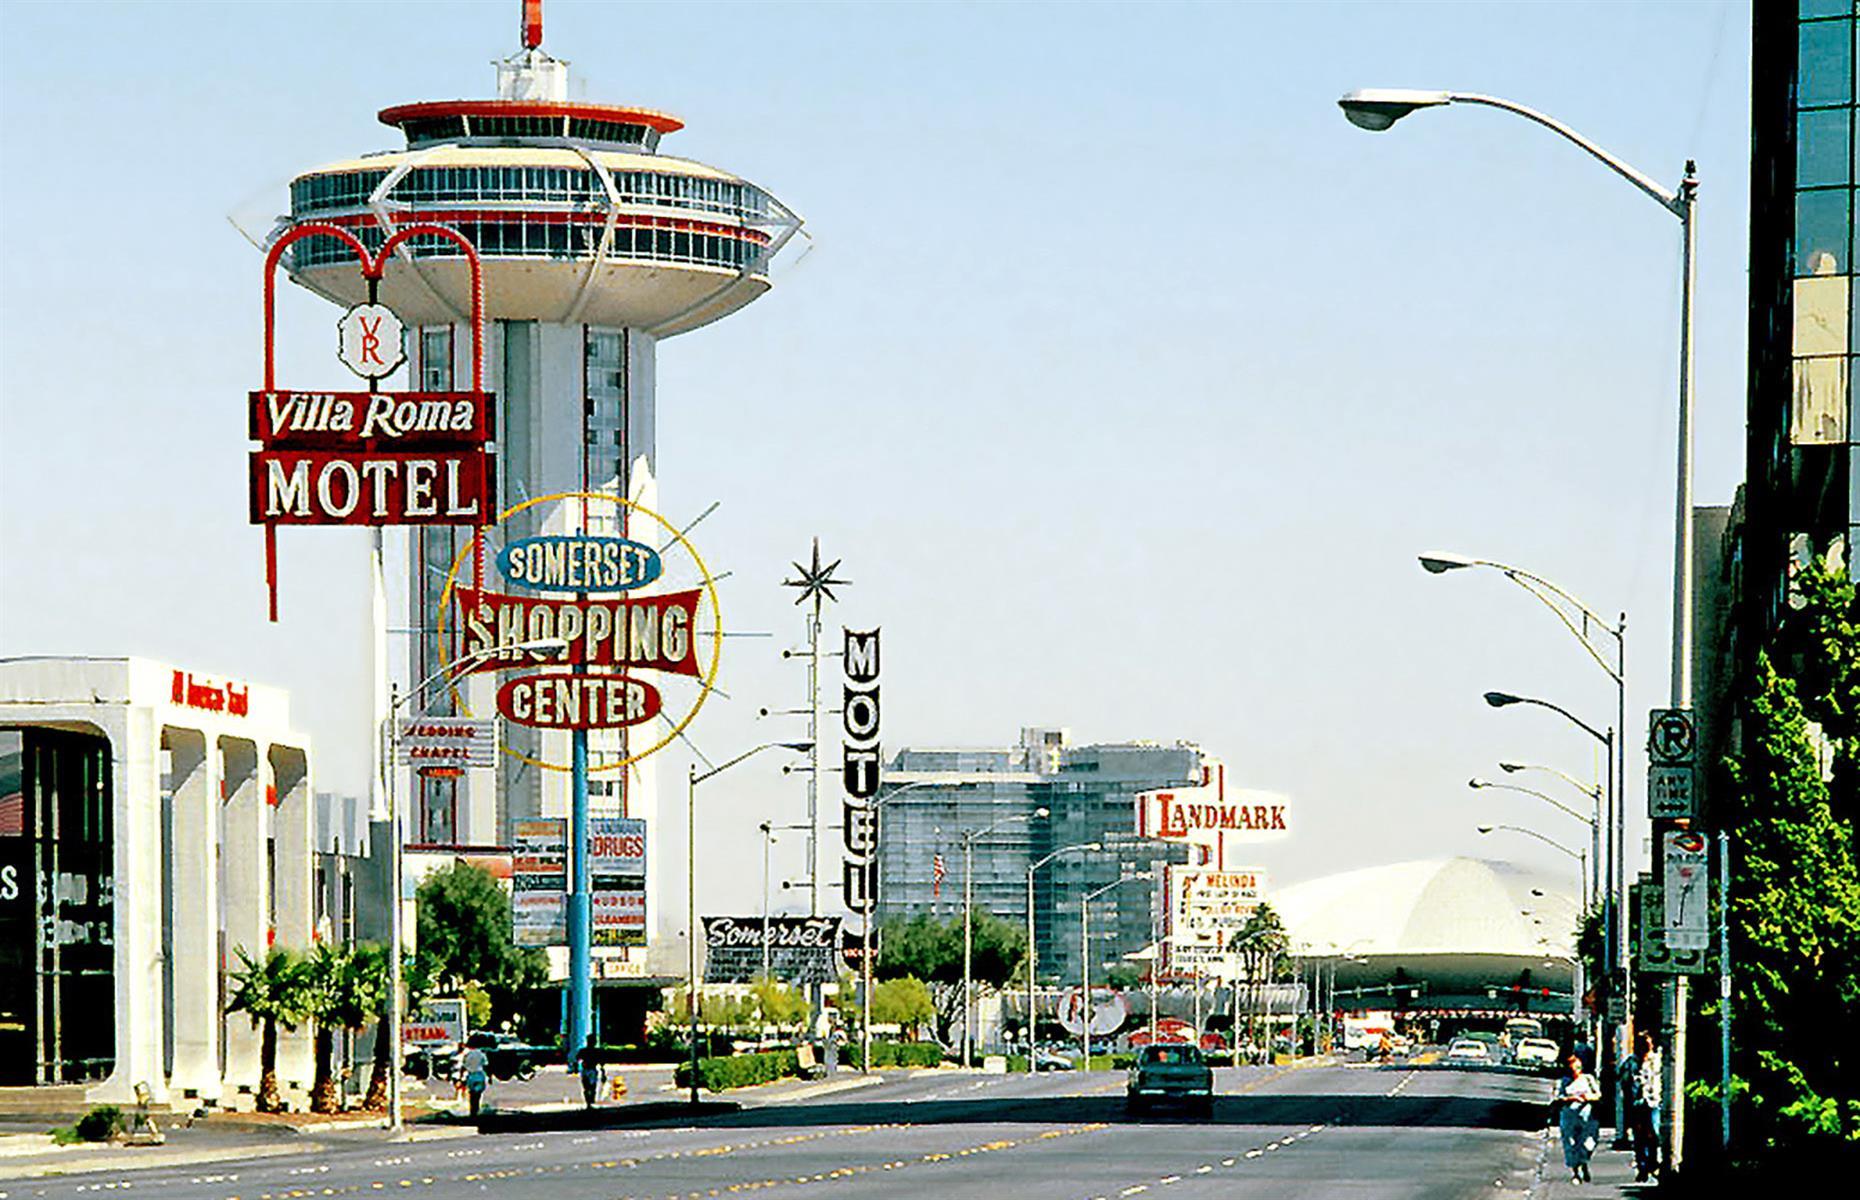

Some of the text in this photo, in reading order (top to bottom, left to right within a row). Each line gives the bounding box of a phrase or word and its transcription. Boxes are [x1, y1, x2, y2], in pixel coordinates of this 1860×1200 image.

[266, 393, 475, 437] Villa Roma
[265, 459, 479, 517] MOTEL
[509, 541, 650, 587] SOMERSET
[468, 603, 689, 662] SHOPPING
[512, 678, 646, 724] CENTER
[846, 635, 877, 908] MOTEL
[1657, 776, 1687, 786] ANY
[1156, 793, 1287, 837] LANDMARK
[593, 836, 644, 858] DRUGS
[0, 864, 19, 900] S
[706, 917, 834, 947] Somerset
